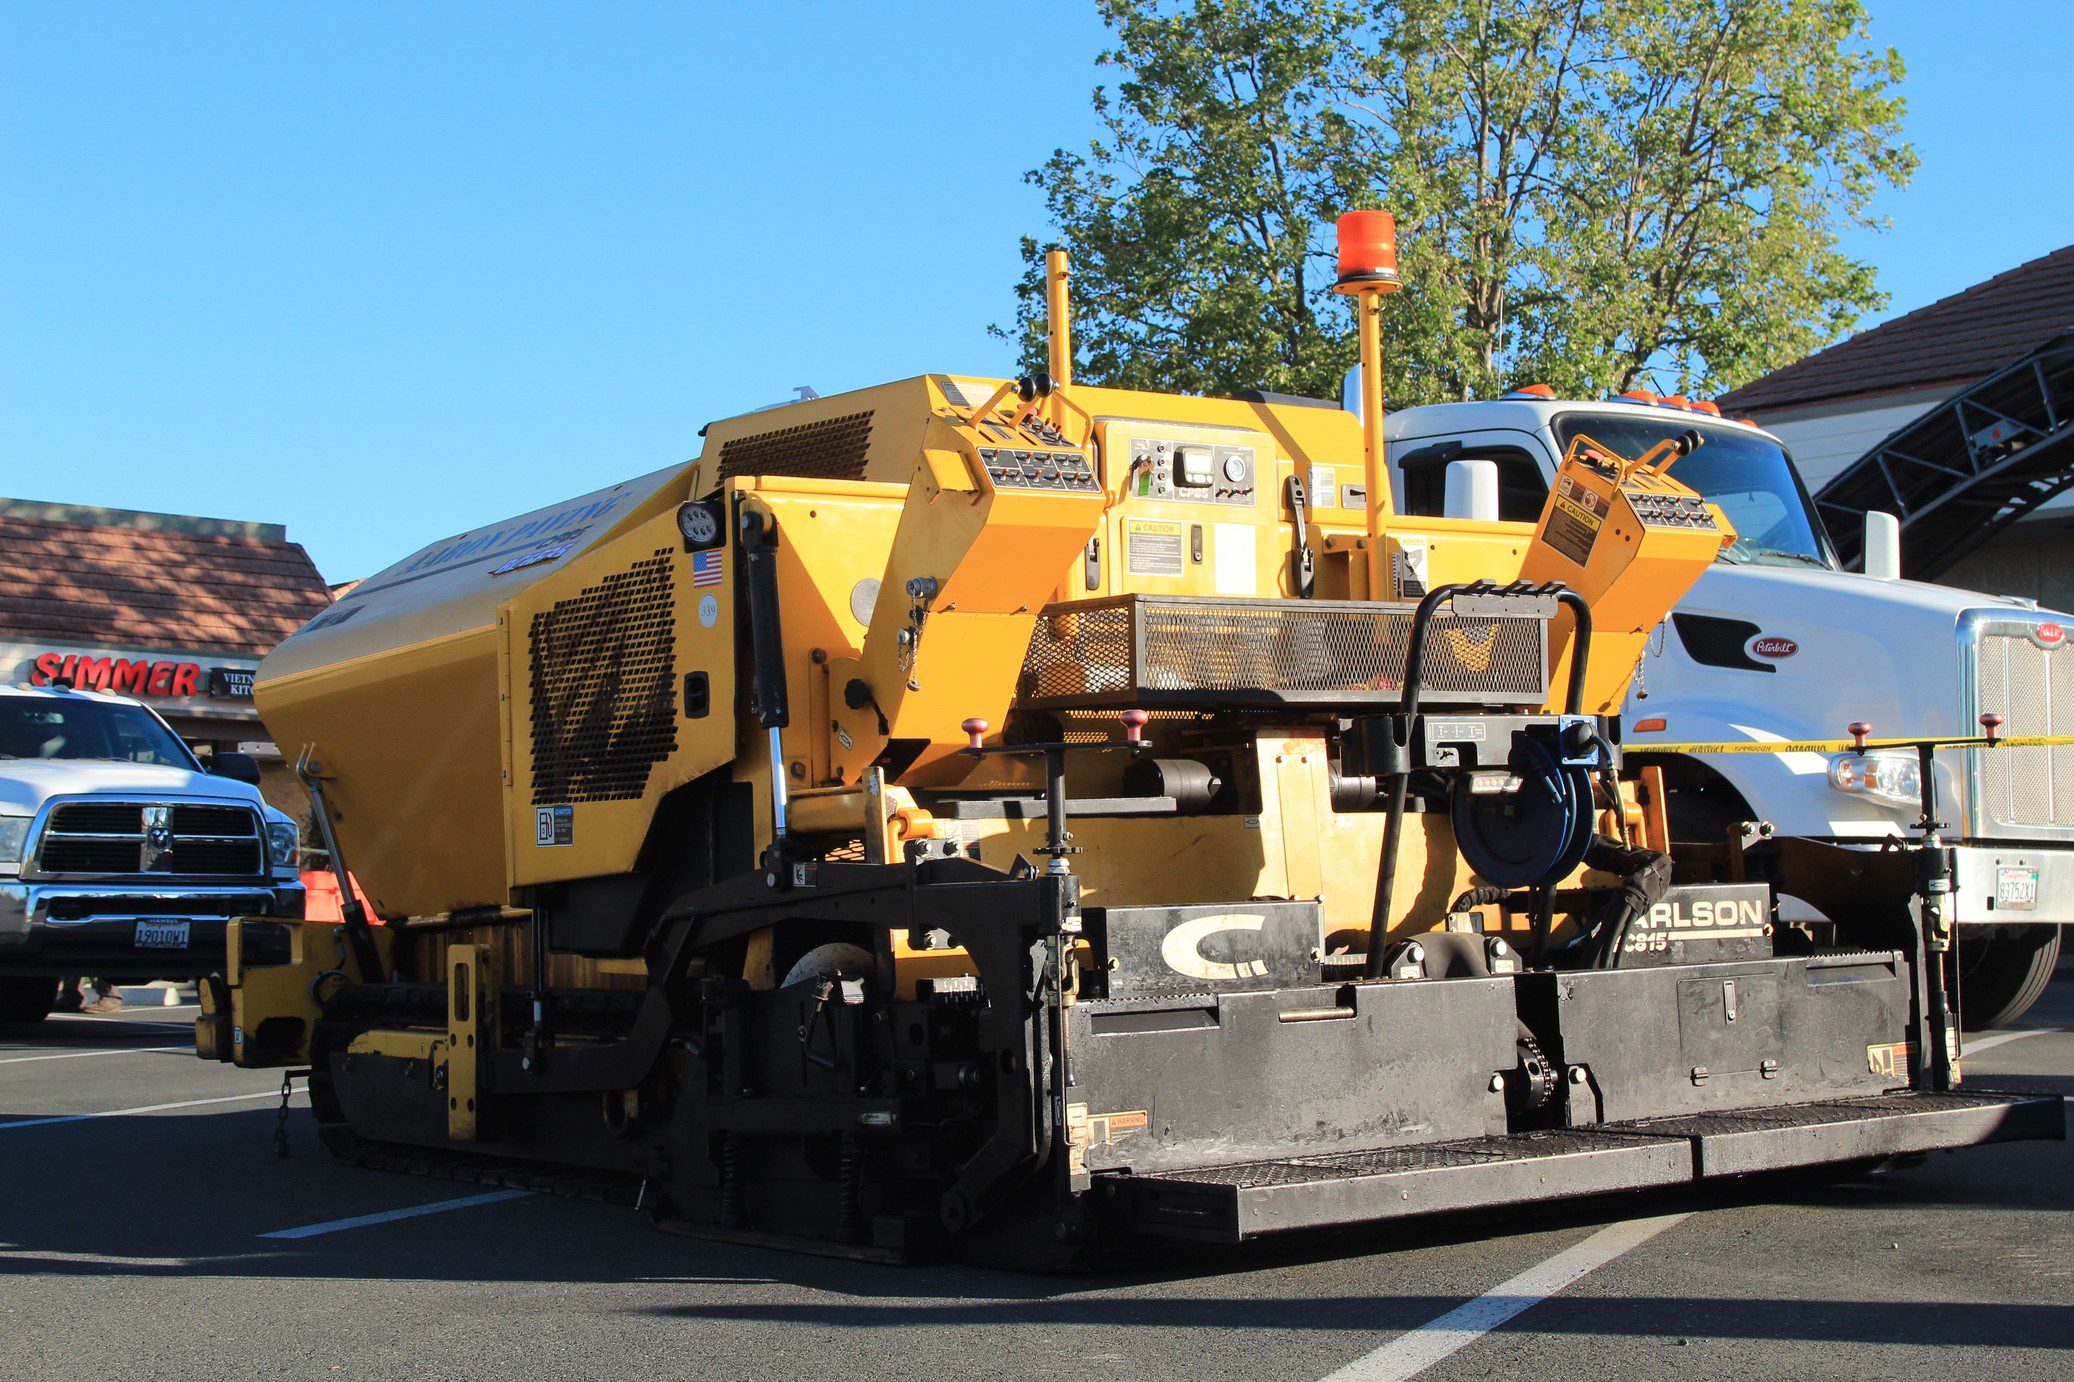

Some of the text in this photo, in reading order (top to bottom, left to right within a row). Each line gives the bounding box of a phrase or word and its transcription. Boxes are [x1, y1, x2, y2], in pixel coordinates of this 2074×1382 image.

[1567, 504, 1595, 526] CAUTION
[1143, 523, 1175, 533] CAUTION
[1757, 640, 1794, 653] Peterbilt
[31, 652, 201, 697] SIMMER
[1999, 881, 2034, 900] 83752X1
[1116, 1115, 1144, 1126] WARNING
